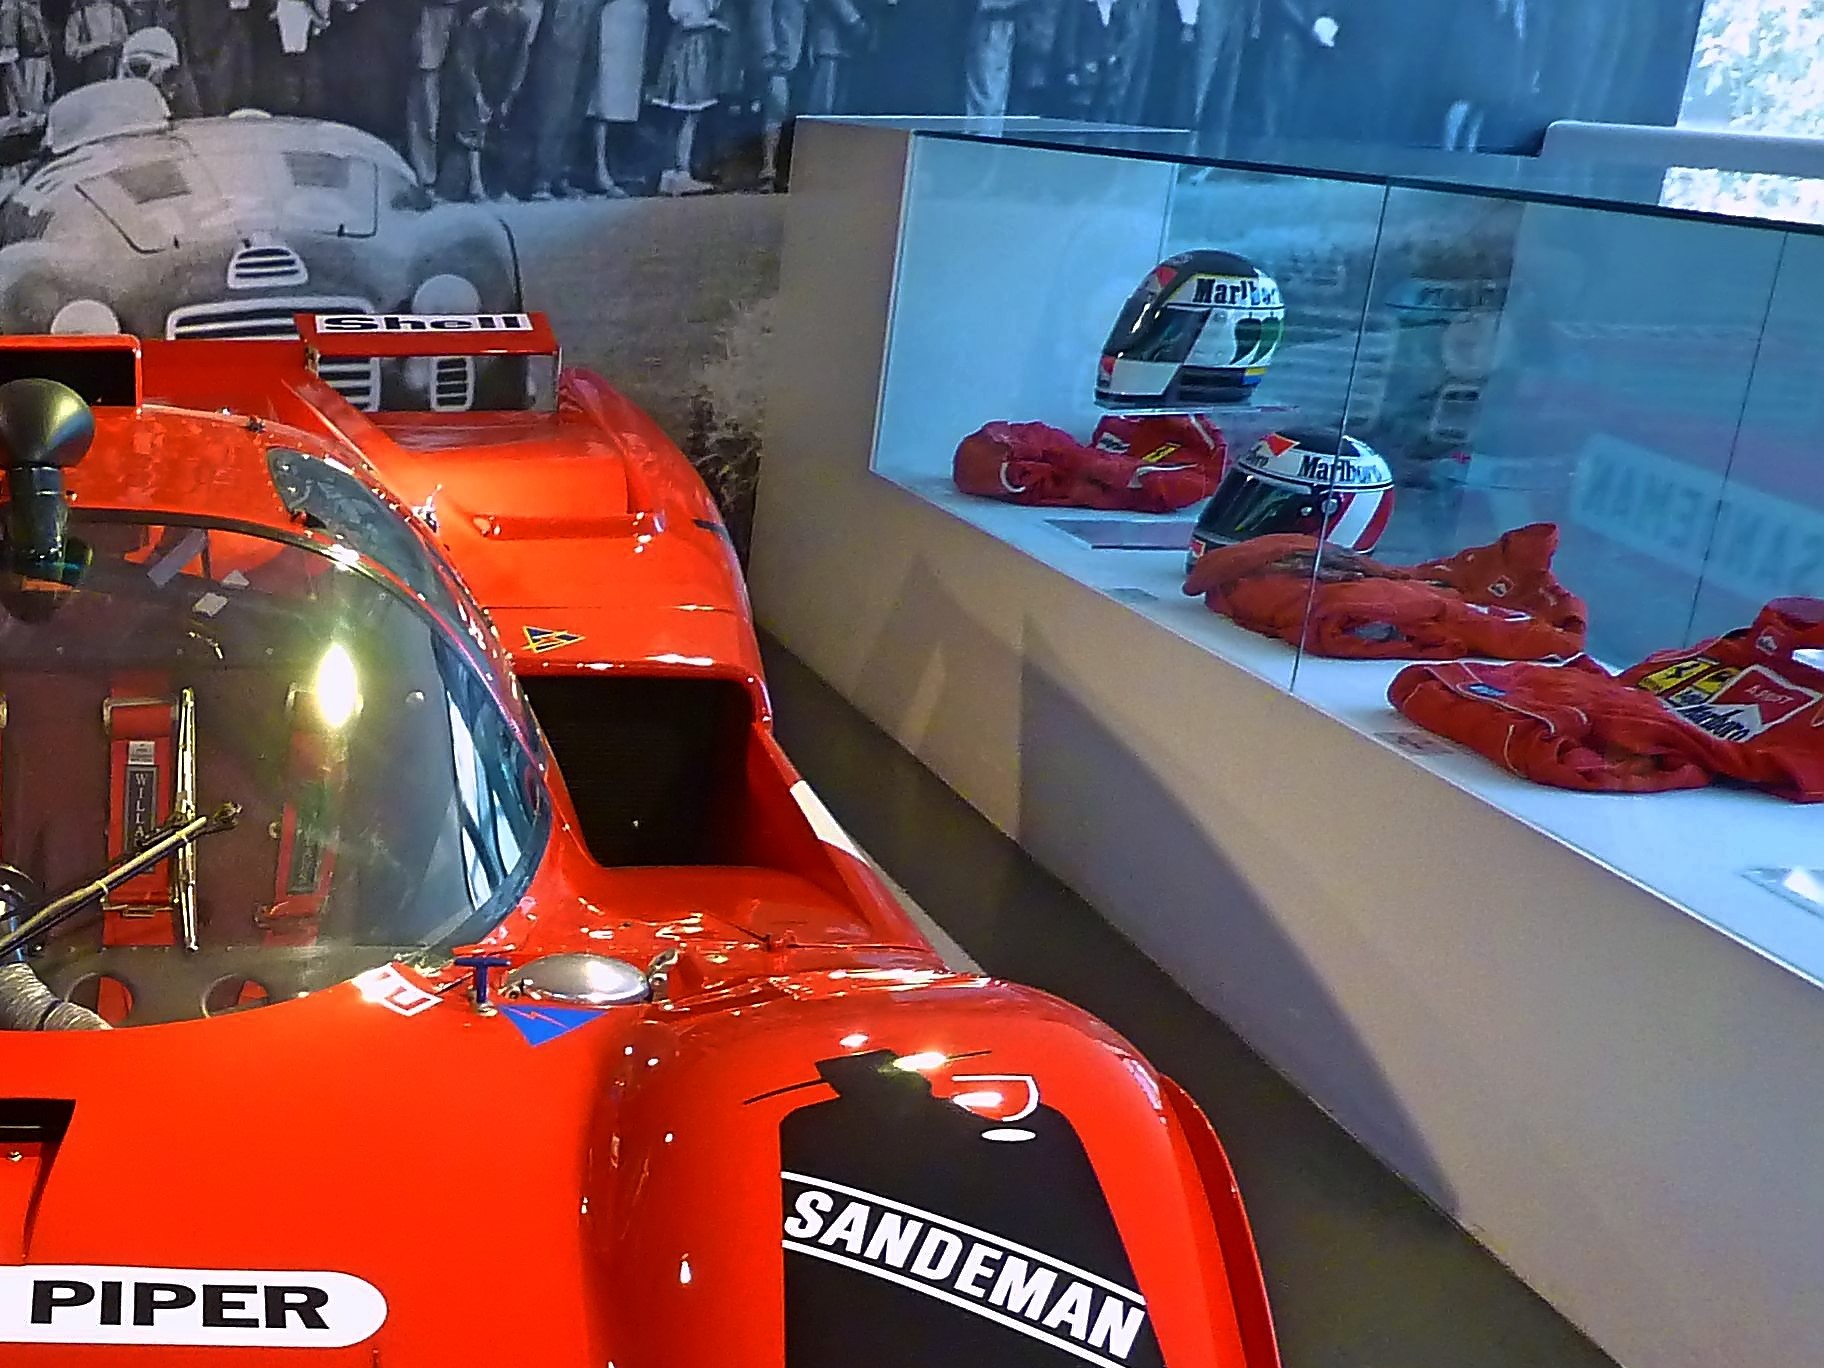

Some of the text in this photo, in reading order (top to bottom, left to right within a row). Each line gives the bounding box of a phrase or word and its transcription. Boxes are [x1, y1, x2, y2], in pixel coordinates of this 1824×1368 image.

[325, 316, 521, 331] Shell
[783, 1190, 1146, 1360] SANDEMAN
[30, 1280, 331, 1330] PIPER
